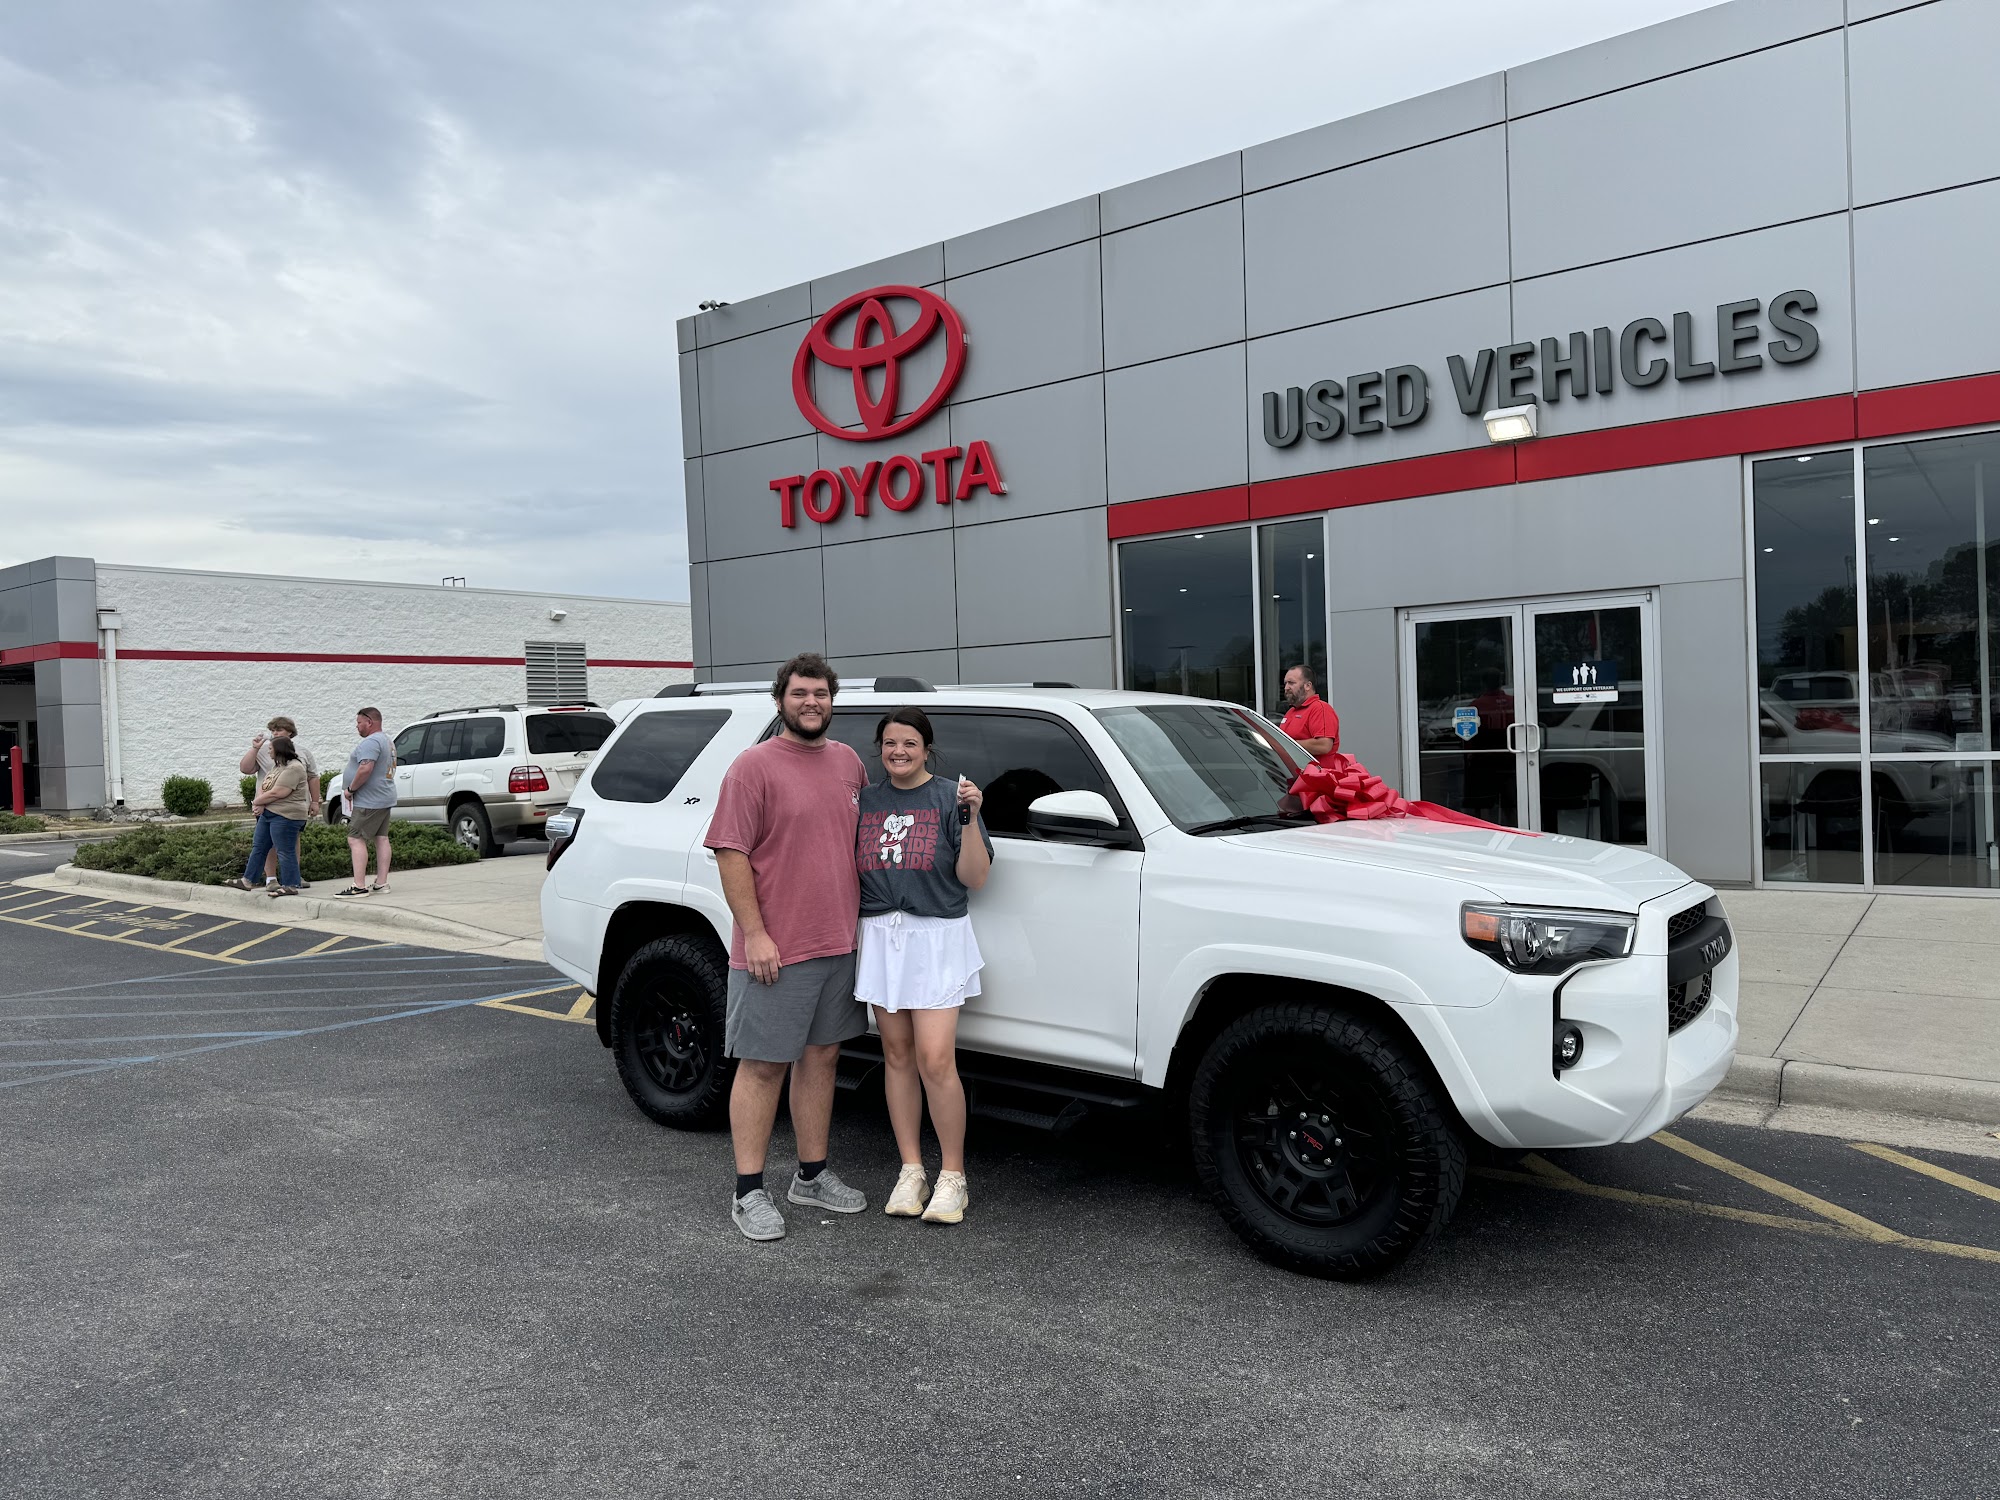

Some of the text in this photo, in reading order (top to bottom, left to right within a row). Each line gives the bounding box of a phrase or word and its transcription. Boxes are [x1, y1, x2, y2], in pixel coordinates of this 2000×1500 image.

[1262, 288, 1820, 449] USED VEHICLES
[769, 440, 1007, 528] TOYOTA
[907, 824, 939, 840] IDE
[1302, 1131, 1324, 1150] TRD
